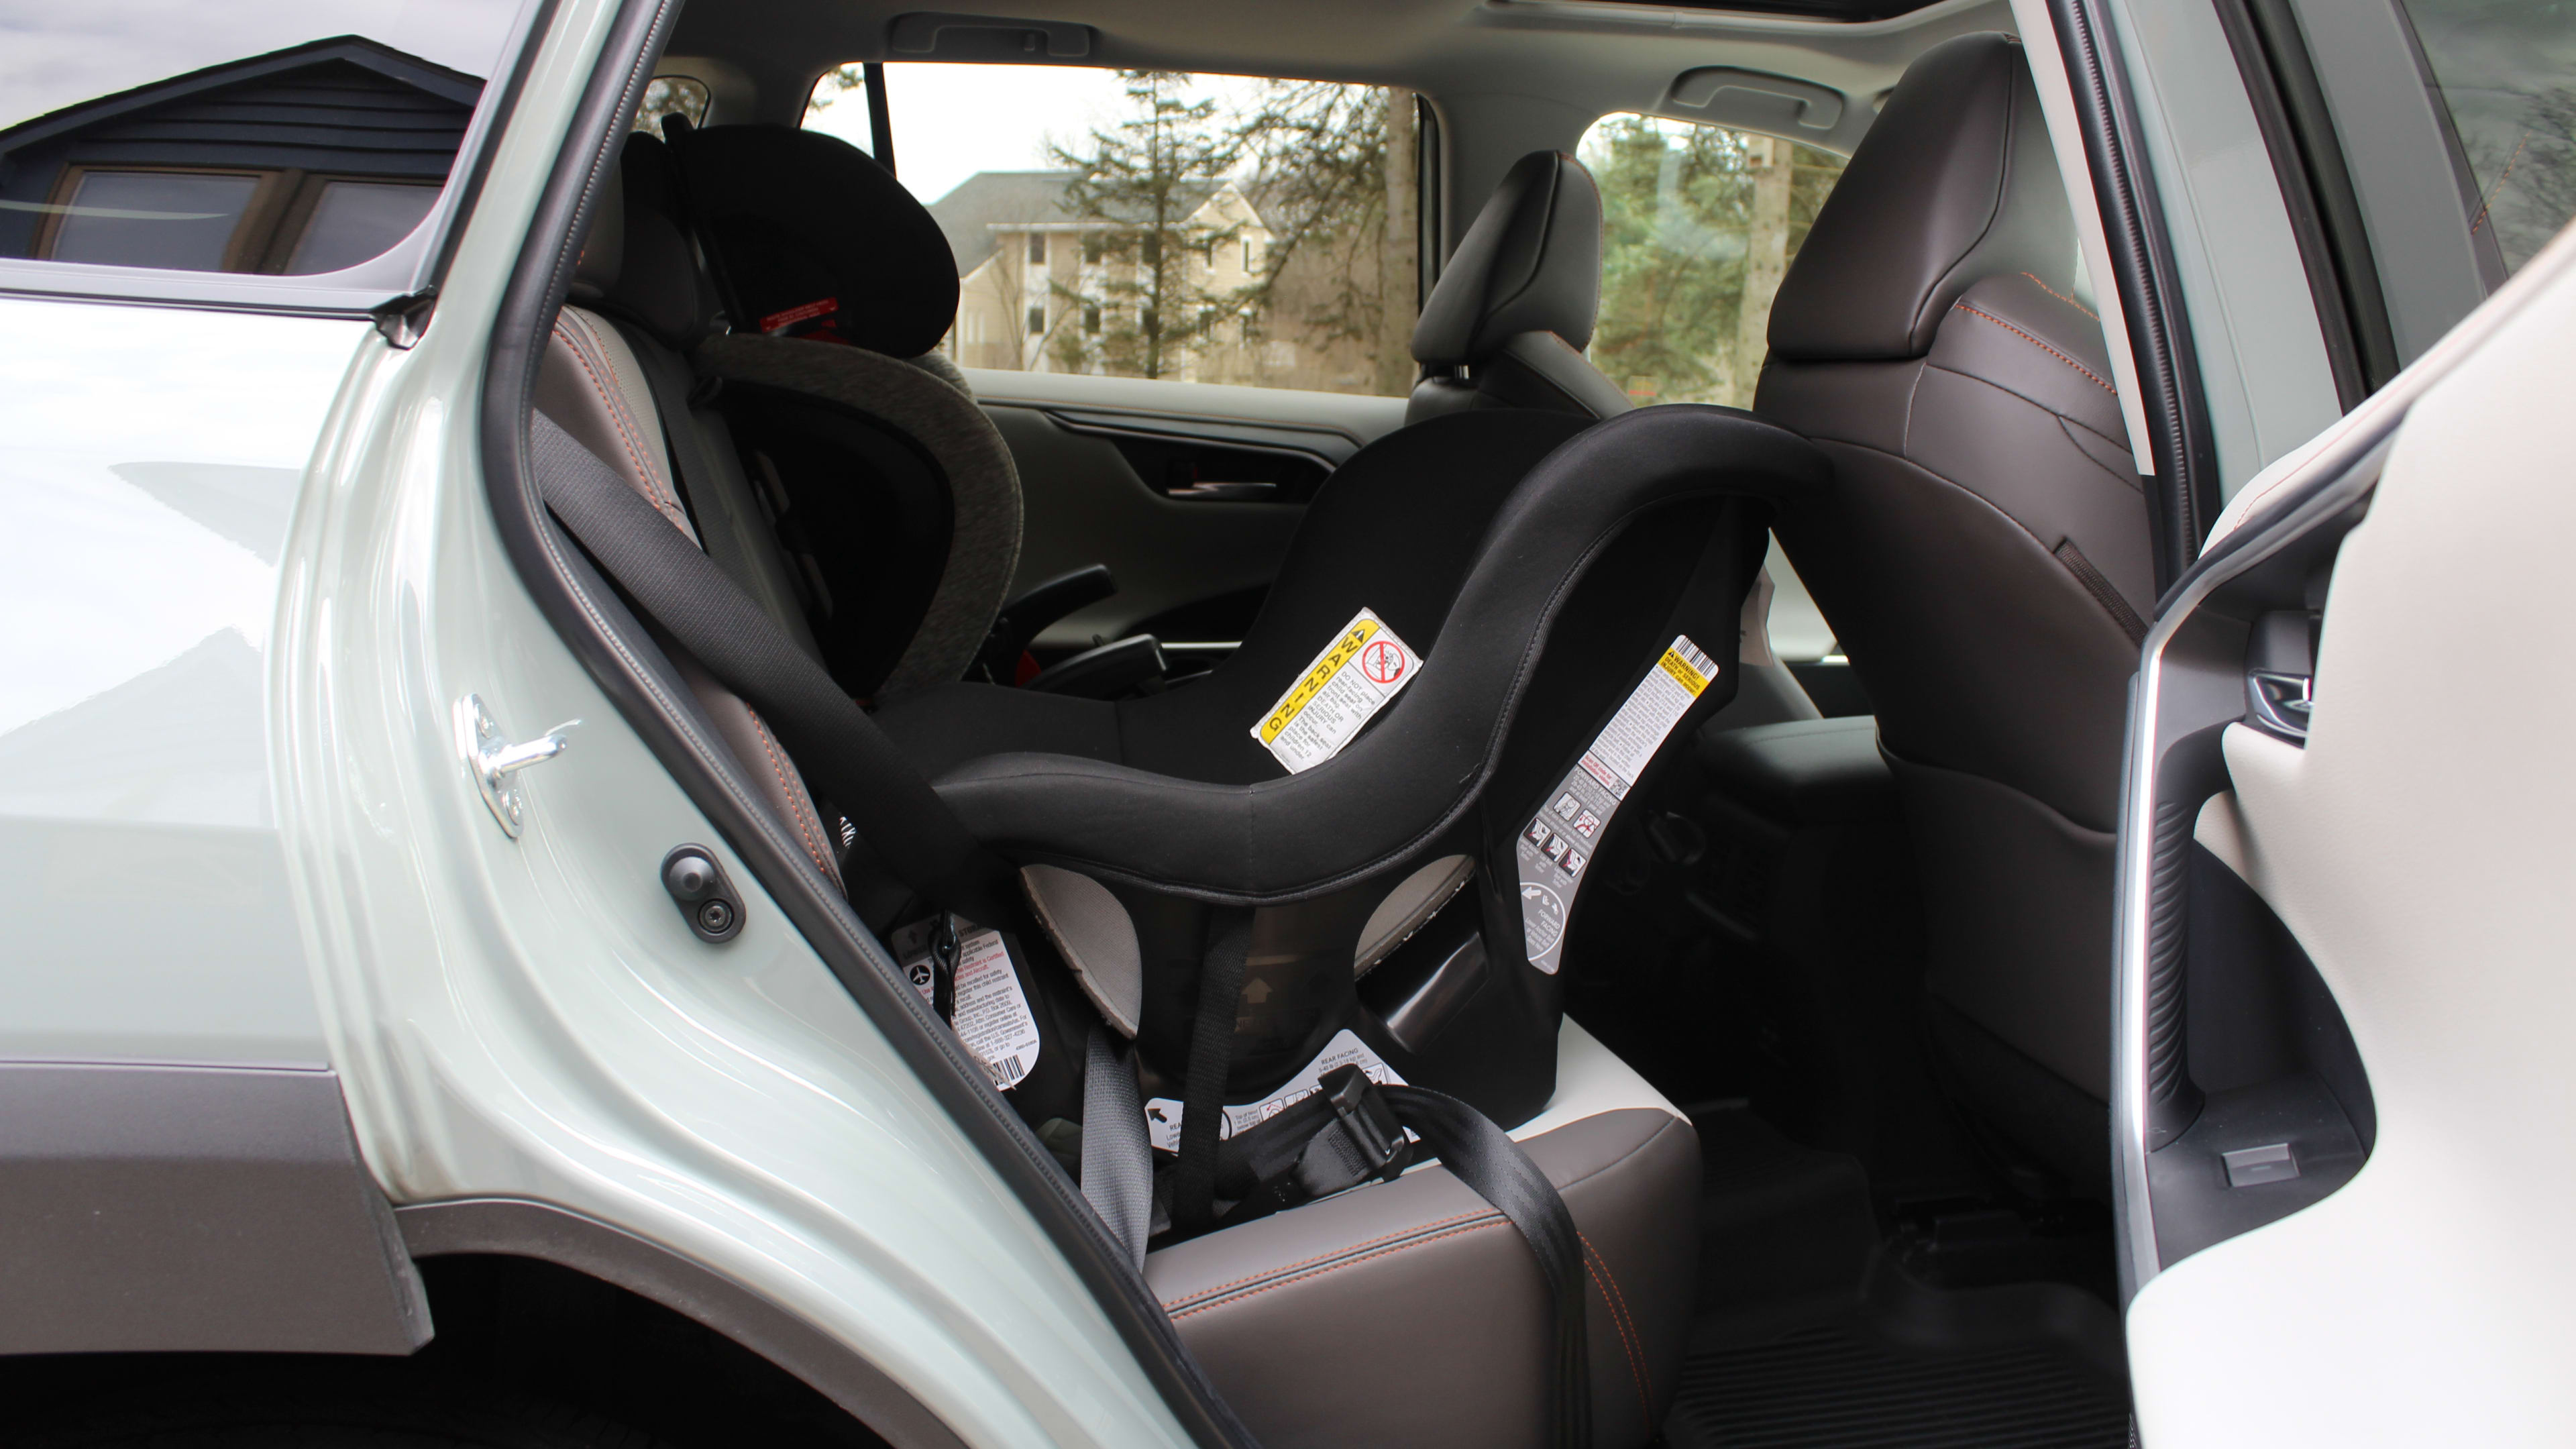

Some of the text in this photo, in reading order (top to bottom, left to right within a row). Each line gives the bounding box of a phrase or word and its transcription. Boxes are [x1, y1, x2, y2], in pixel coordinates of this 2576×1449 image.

[1660, 660, 1676, 676] INJURY
[1674, 674, 1684, 684] can
[1664, 656, 1679, 670] DEATH
[1681, 672, 1701, 690] SERIOUS
[1672, 655, 1701, 680] WARNING!
[1268, 636, 1359, 732] WARNING
[1322, 690, 1330, 698] air
[1331, 680, 1363, 712] child seat on
[1335, 675, 1363, 704] rear-facing
[1340, 670, 1376, 706] DO NOT place
[1311, 699, 1336, 724] SERIOUS
[1316, 695, 1344, 722] DEATH OR
[1326, 684, 1362, 720] front seat with
[1307, 704, 1337, 735] INJURY can
[1279, 735, 1291, 747] and
[1283, 730, 1312, 757] children 12
[1287, 725, 1311, 747] place for
[1297, 716, 1332, 750] The back seat
[1298, 725, 1308, 736] the
[1307, 733, 1324, 751] safest
[1573, 765, 1600, 790] FORWARD
[1597, 786, 1618, 806] FACING
[1536, 908, 1562, 930] FORWARD
[1320, 1047, 1358, 1065] REAR FACING
[1165, 1131, 1181, 1140] Lowe
[1169, 1122, 1181, 1130] REA
